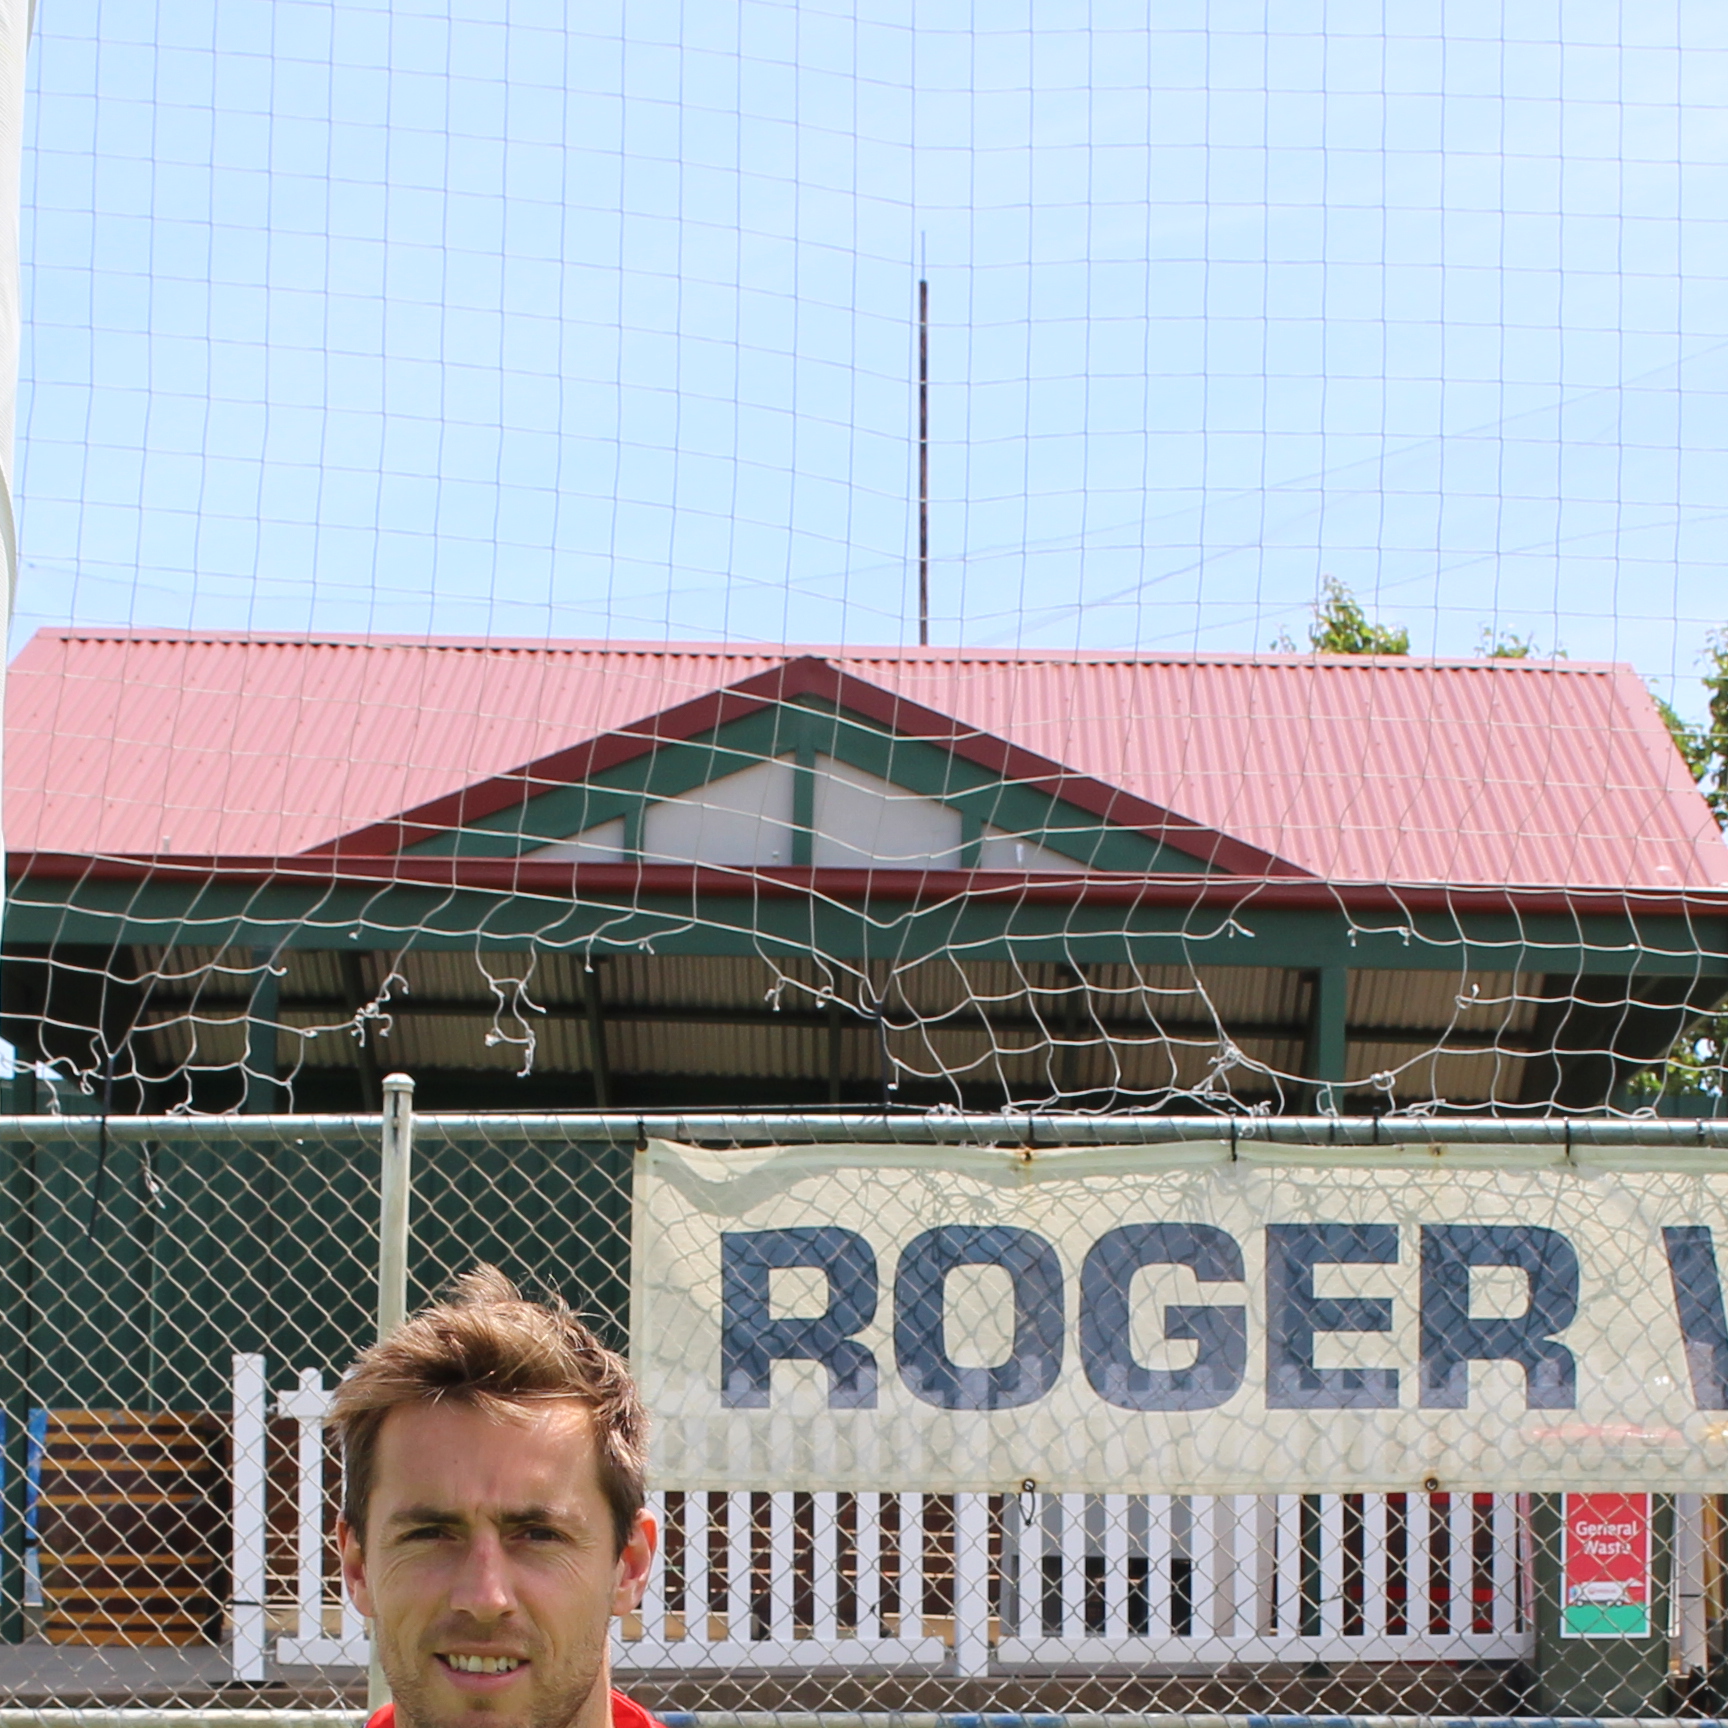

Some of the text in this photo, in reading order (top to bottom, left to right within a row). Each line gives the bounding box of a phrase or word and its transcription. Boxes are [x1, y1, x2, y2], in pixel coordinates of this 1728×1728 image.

[719, 1220, 1582, 1412] ROGER
[1575, 1520, 1638, 1538] General
[1584, 1540, 1632, 1556] Waste
